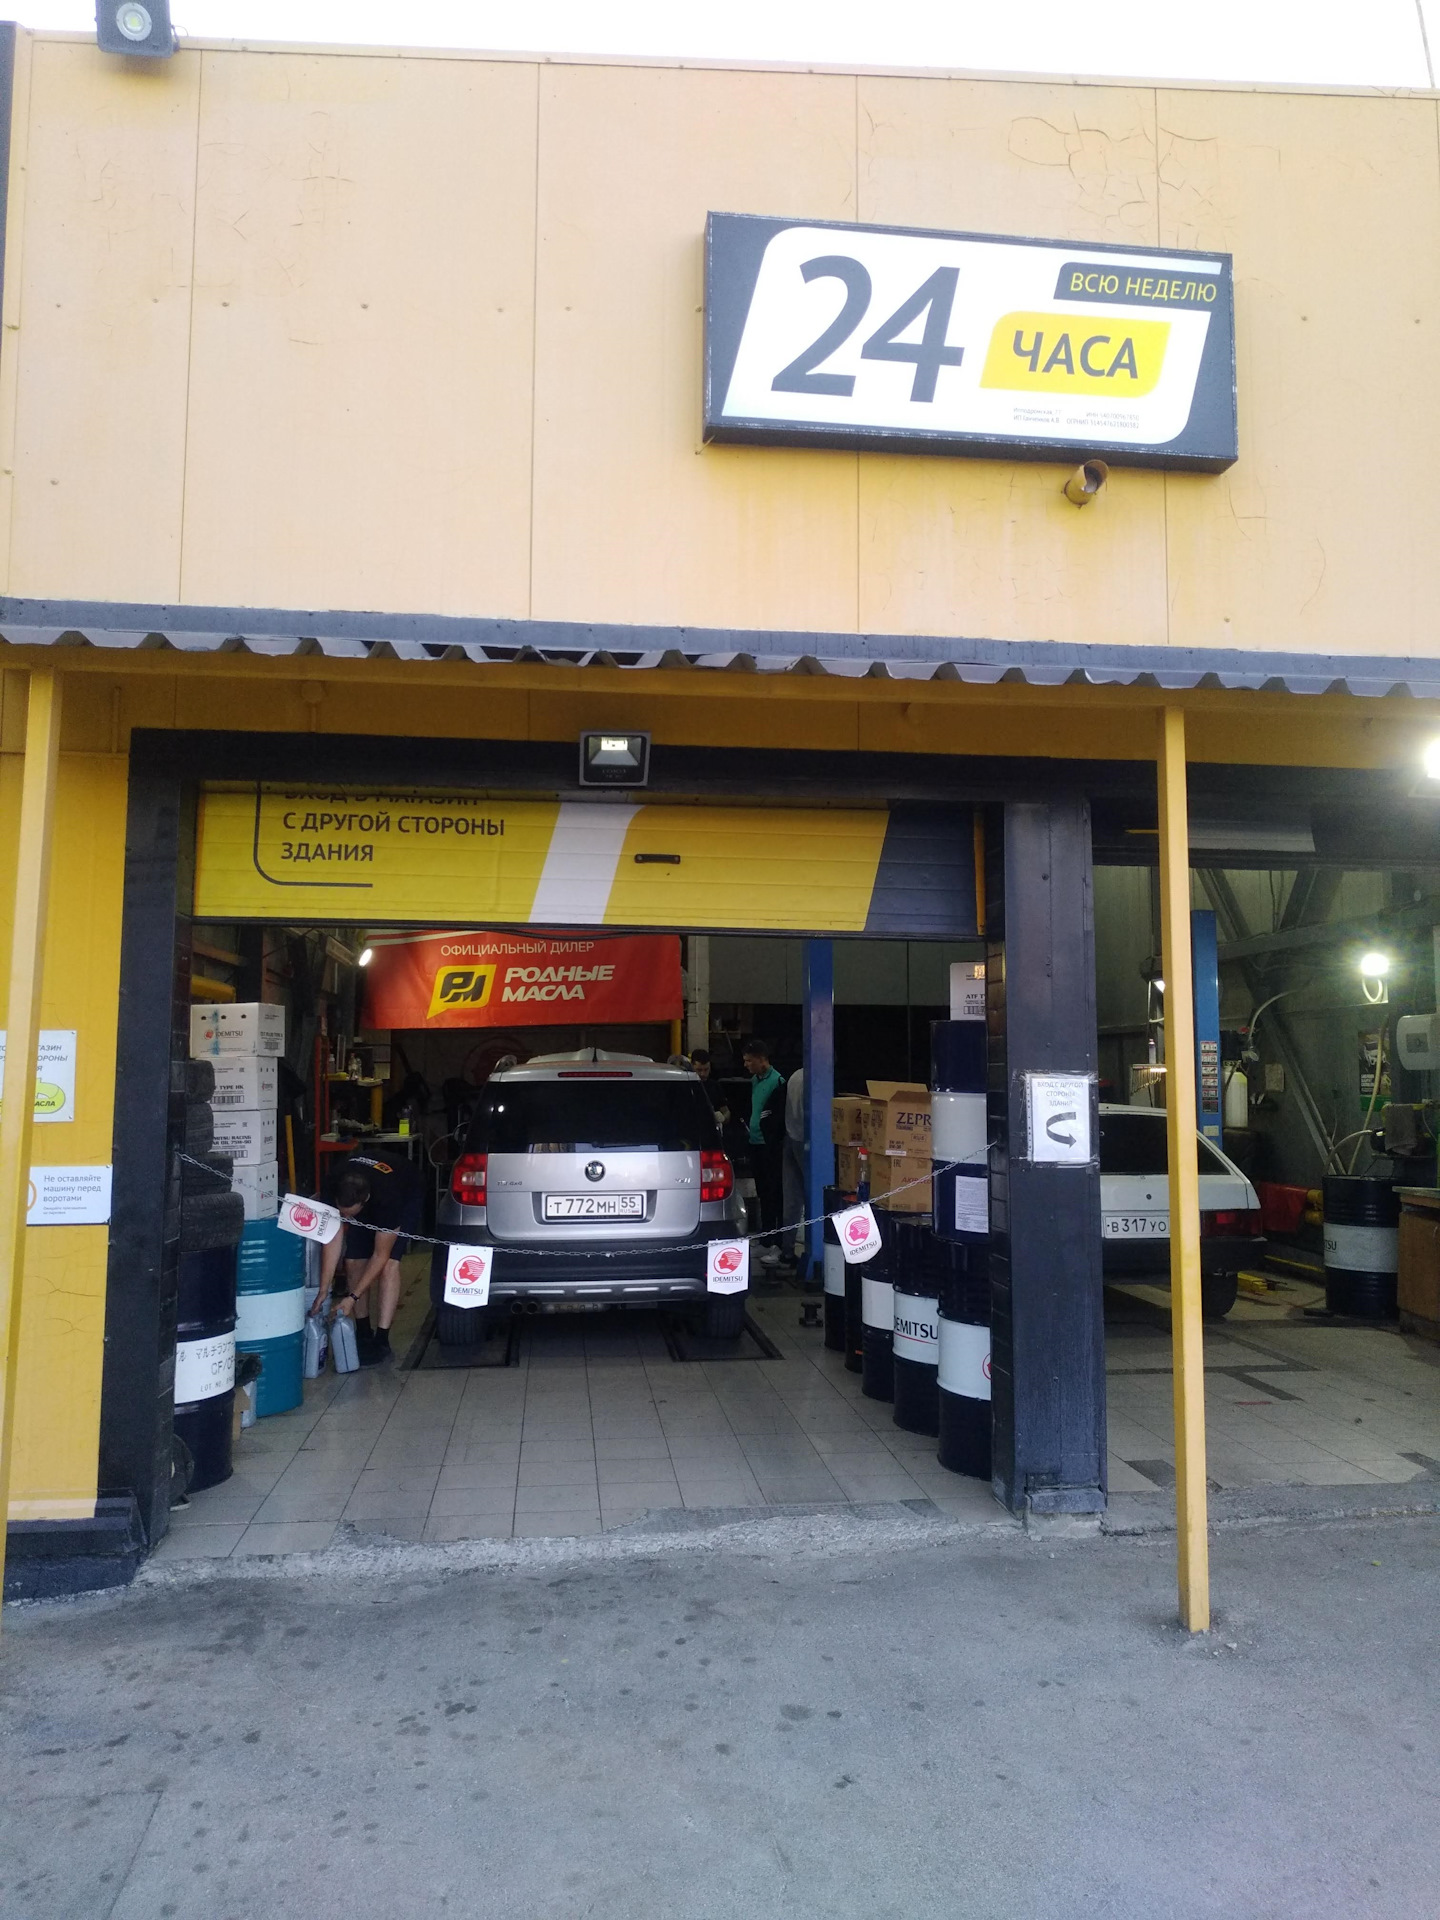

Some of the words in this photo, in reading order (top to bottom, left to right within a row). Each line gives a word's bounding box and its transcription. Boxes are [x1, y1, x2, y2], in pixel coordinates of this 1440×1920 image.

[1069, 272, 1119, 293] ВСЮ
[1123, 276, 1217, 303] НЕДЕЛЮ
[770, 255, 964, 403] 24
[1011, 329, 1138, 380] ЧАСА
[283, 811, 297, 829] С
[301, 811, 390, 833] ДРУГОЙ
[397, 815, 505, 836] СТОРОНЫ
[281, 842, 374, 863] ЗДАНИЯ
[440, 941, 547, 957] ОФИЦИАЛЬНЫЙ
[550, 941, 595, 955] ДИЛЕР
[504, 964, 616, 984] РОДНЫЕ
[500, 984, 586, 1002] МАСЛА
[1060, 1081, 1084, 1089] ДРУГОЙ
[57, 1174, 102, 1182] оставляйте
[77, 1185, 101, 1193] перед
[43, 1195, 82, 1203] воротами
[620, 1196, 636, 1208] 55
[1111, 1218, 1166, 1232] В317УО
[849, 1240, 877, 1255] IDEMITSU
[450, 1286, 484, 1295] IDEMITSU
[894, 1315, 938, 1340] EMITSU
